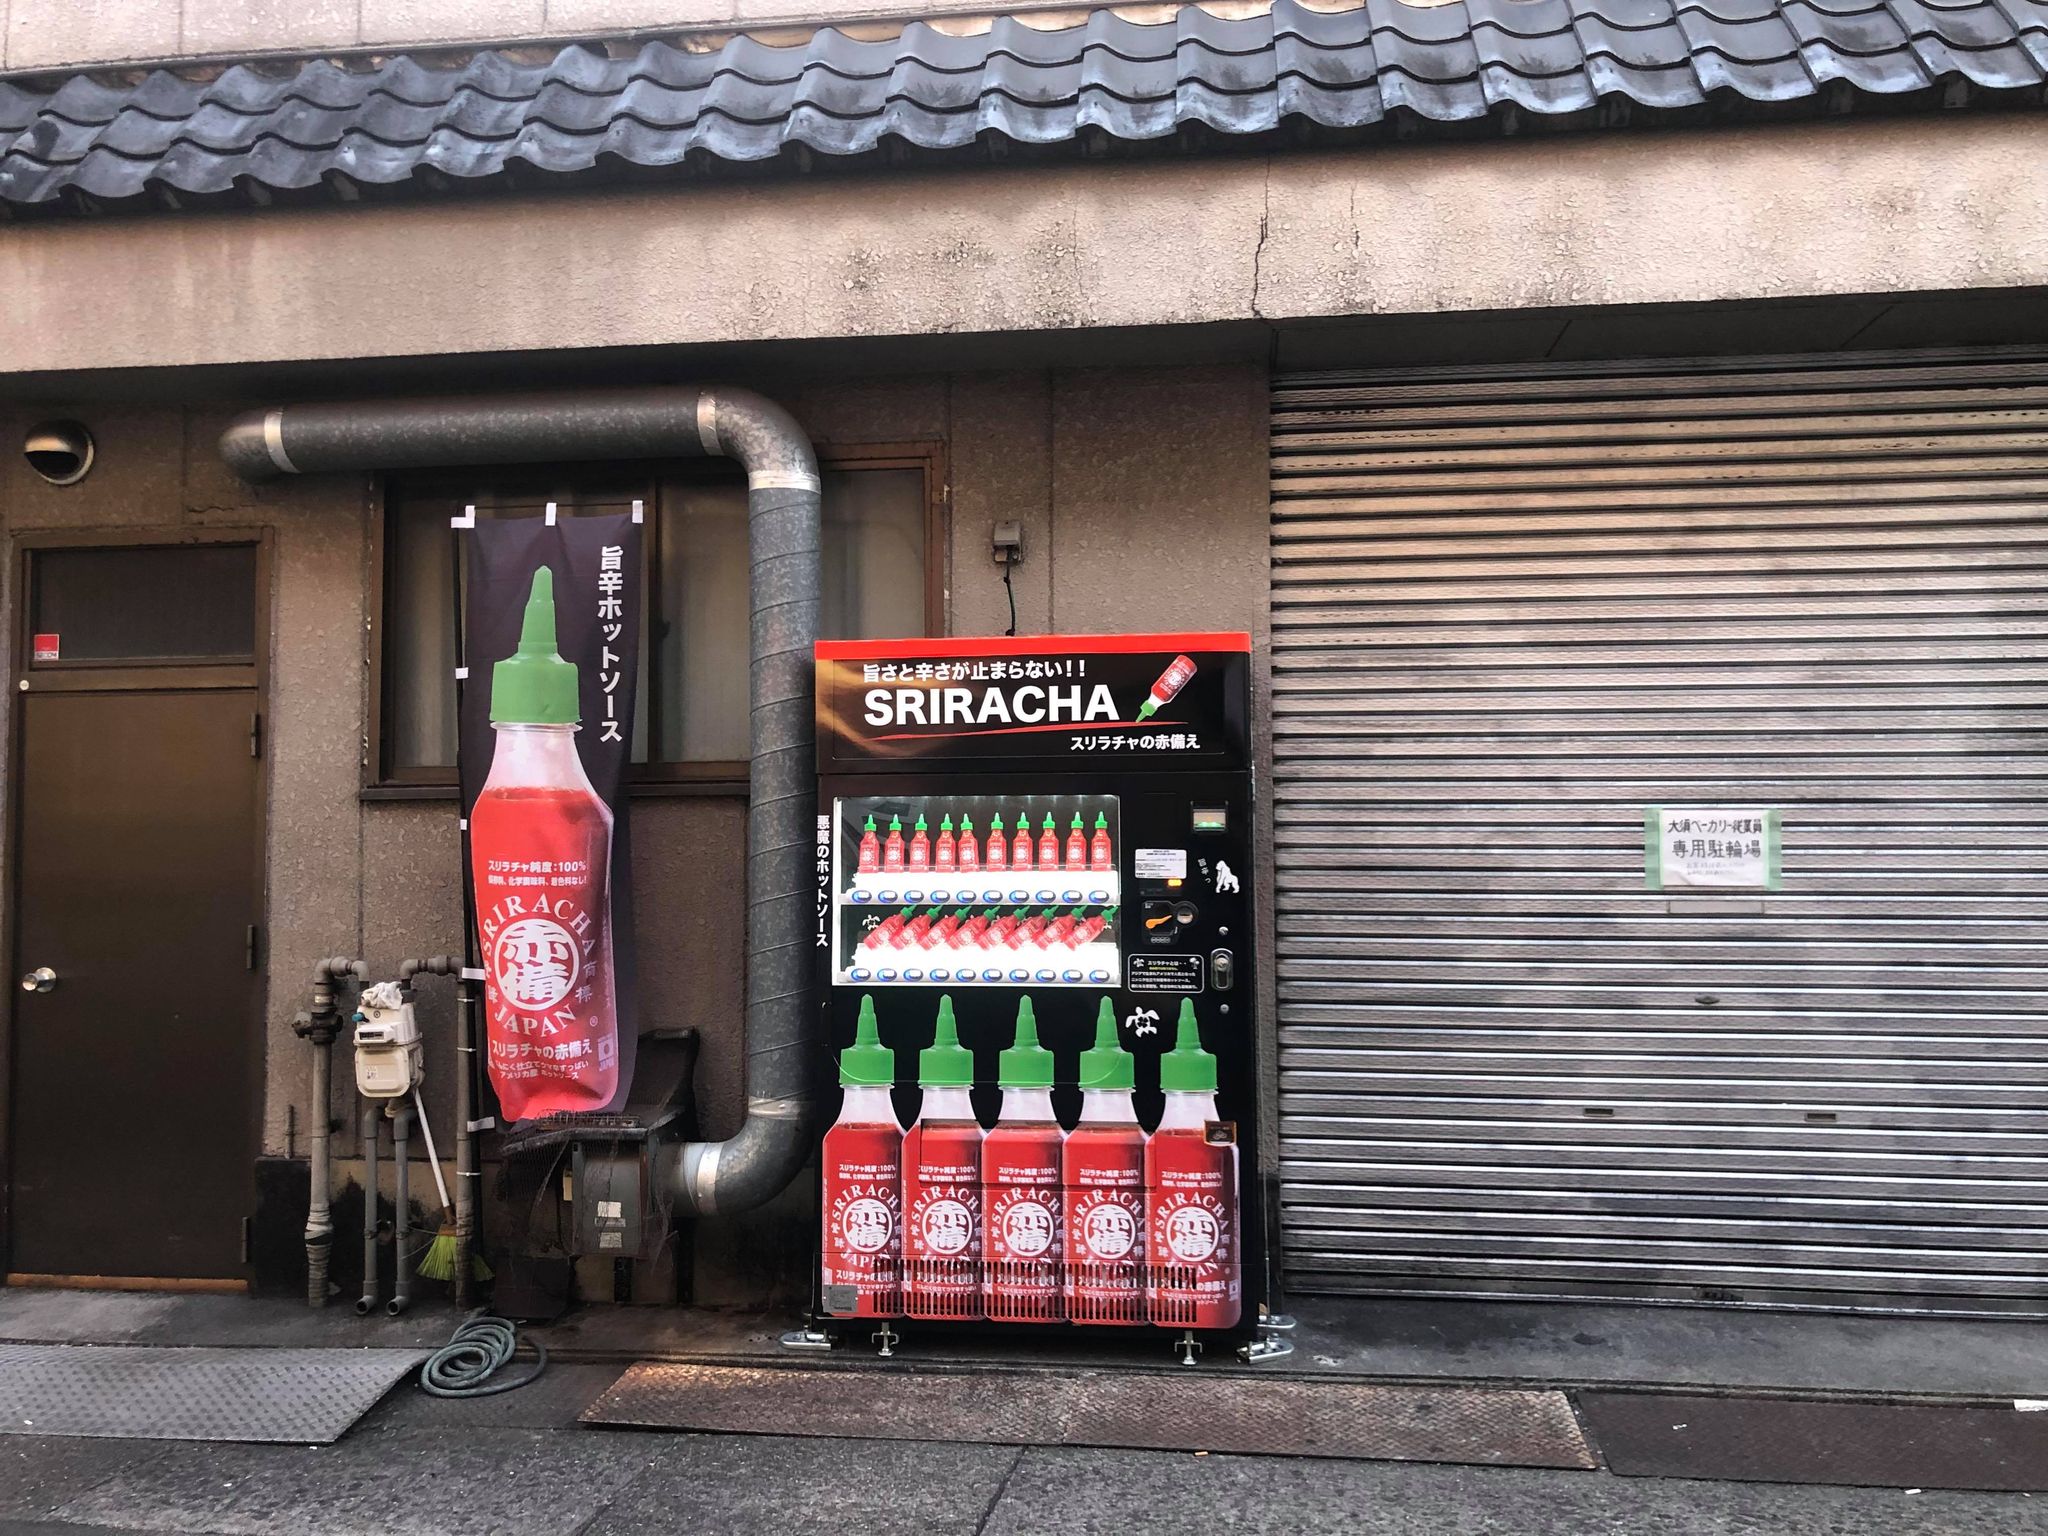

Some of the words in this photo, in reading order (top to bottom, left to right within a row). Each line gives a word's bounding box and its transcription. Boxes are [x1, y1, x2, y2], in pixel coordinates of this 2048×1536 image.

[598, 545, 623, 743] 旨辛ホットソース
[863, 660, 1087, 682] 旨さと辛さが止まらない!!
[864, 683, 1120, 726] SRIRACHA
[1070, 733, 1201, 751] スリラチャの赤備え
[1672, 839, 1762, 859] 専用駐輪場
[816, 814, 830, 947] 悪魔のホットソース
[483, 892, 596, 957] SRIRACHA
[494, 1003, 577, 1038] JAPAN
[492, 1038, 593, 1060] スリラチャの赤備え
[832, 1183, 902, 1221] SRIRACHA
[911, 1185, 982, 1223] SRIRACHA
[991, 1186, 1064, 1226] SRIRACHA
[1073, 1188, 1145, 1229] SRIRACHA
[1154, 1191, 1229, 1230] SRIRACHA
